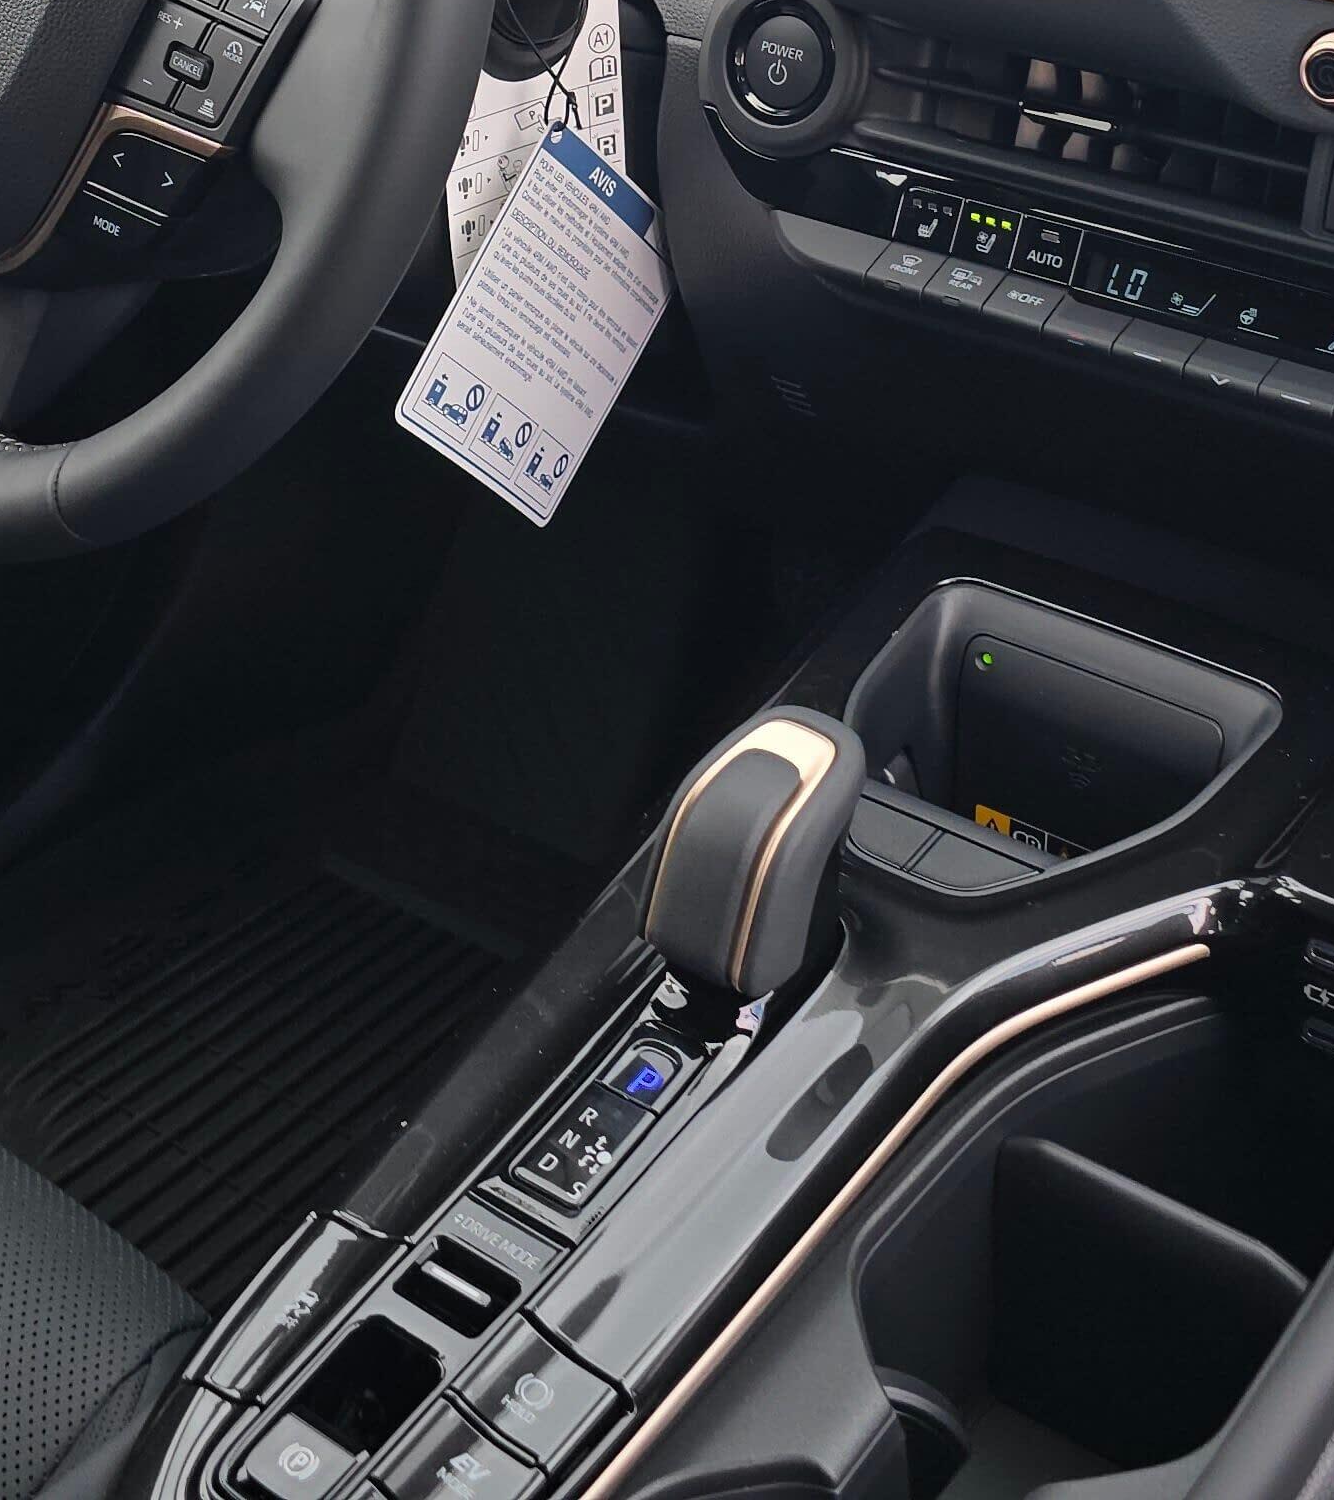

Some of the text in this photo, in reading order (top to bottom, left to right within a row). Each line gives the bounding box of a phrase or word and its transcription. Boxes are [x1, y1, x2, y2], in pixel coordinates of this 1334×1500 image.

[157, 10, 172, 25] RES
[593, 32, 610, 49] A1
[760, 40, 804, 62] POWER
[171, 55, 202, 78] CANCEL
[223, 49, 243, 66] MODE
[587, 166, 618, 199] AVIS
[92, 214, 121, 238] MODE
[1026, 249, 1064, 269] AUTO
[889, 263, 920, 277] FRONT
[947, 279, 972, 292] REAR
[1106, 263, 1149, 301] LO
[1016, 293, 1045, 306] OFF
[627, 1066, 664, 1093] P
[578, 1106, 599, 1127] R
[558, 1128, 581, 1150] N
[537, 1151, 559, 1172] D
[566, 1181, 588, 1201] S
[461, 1216, 541, 1270] DRIVE MODE
[449, 1452, 492, 1481] EV
